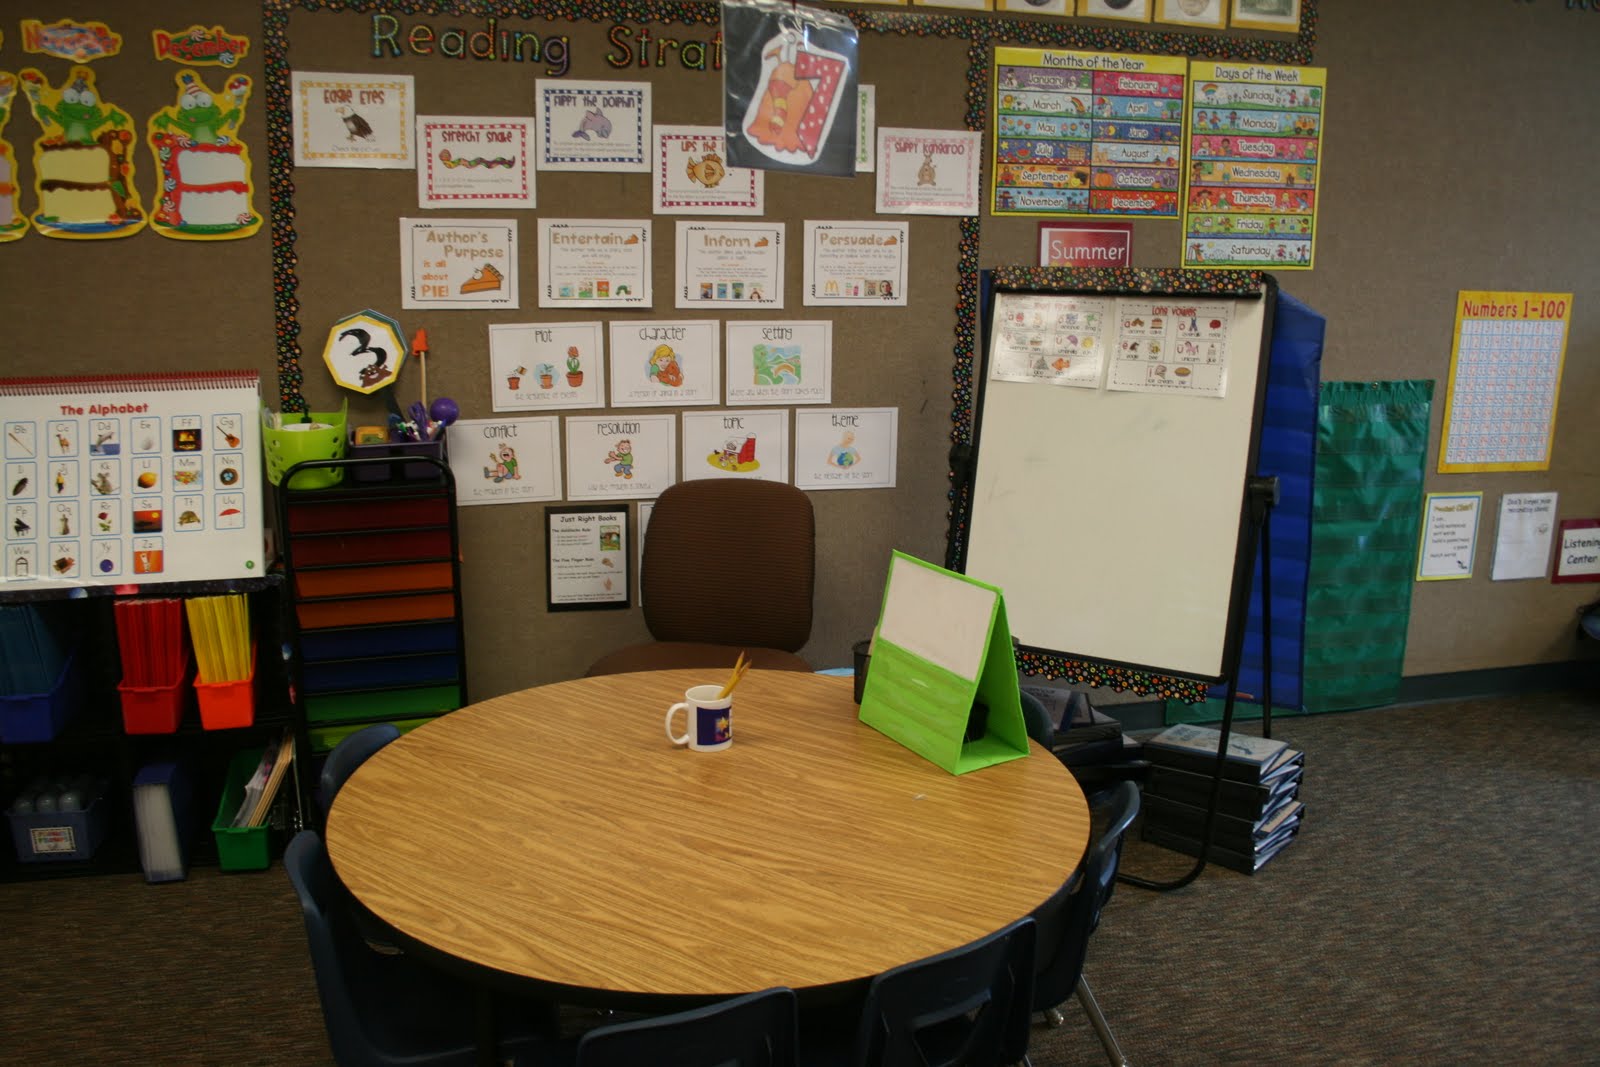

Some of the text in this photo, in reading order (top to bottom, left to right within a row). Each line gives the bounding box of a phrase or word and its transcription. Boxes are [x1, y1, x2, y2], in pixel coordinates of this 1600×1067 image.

[156, 29, 246, 57] December
[373, 14, 570, 75] Reading
[1043, 53, 1144, 70] Months of the Year
[1215, 66, 1298, 81] Days of the Week
[1028, 75, 1064, 87] January
[1118, 78, 1158, 92] February
[1242, 90, 1275, 102] Sunday
[1032, 100, 1061, 110] March
[1127, 103, 1148, 115] April
[1037, 122, 1056, 134] May
[1241, 118, 1277, 130] Monday
[1129, 127, 1148, 137] June
[1035, 142, 1053, 156] July
[1238, 140, 1274, 154] Tuesday
[1121, 149, 1150, 160] August
[1021, 171, 1068, 182] September
[1116, 174, 1154, 185] October
[1232, 168, 1280, 180] Wednesday
[1020, 196, 1064, 207] November
[1112, 197, 1155, 208] December
[1233, 192, 1275, 204] Thursday
[1236, 218, 1264, 230] Friday
[426, 230, 488, 243] Author's
[553, 232, 623, 245] Entertain
[704, 234, 750, 247] Inform
[820, 233, 884, 247] Persuade
[444, 245, 504, 260] Purpose
[1051, 239, 1125, 261] Summer
[1231, 245, 1271, 257] Saturday
[424, 259, 447, 268] is all
[421, 272, 448, 281] about
[1463, 300, 1566, 318] Numbers 1-100
[61, 403, 149, 416] The Alphabet
[578, 515, 595, 523] Right
[1567, 554, 1598, 564] Center
